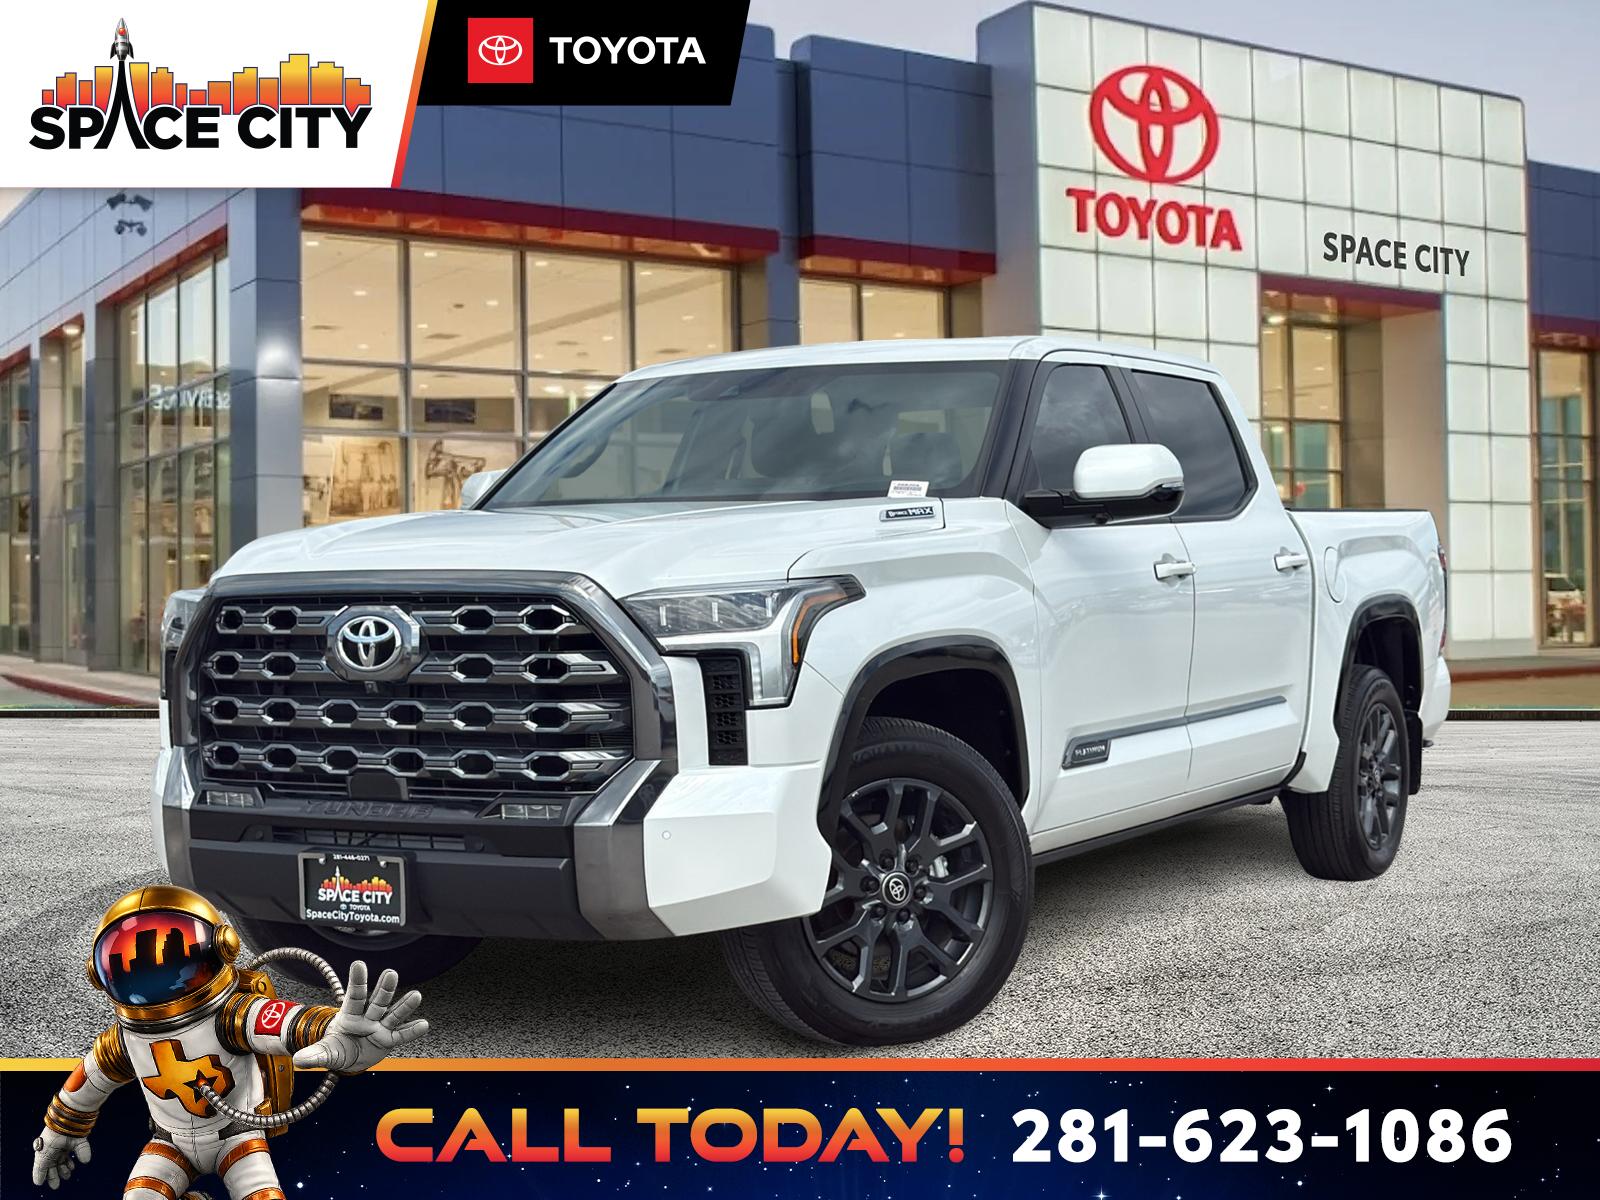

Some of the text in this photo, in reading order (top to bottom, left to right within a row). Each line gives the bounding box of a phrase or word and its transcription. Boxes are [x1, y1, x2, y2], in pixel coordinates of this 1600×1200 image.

[1066, 187, 1242, 252] TOYOTA
[1323, 232, 1470, 276] SPACE CITY
[908, 506, 933, 516] MAX
[318, 887, 393, 905] SPACE CITY
[306, 908, 400, 924] SpaceCityToyota.com
